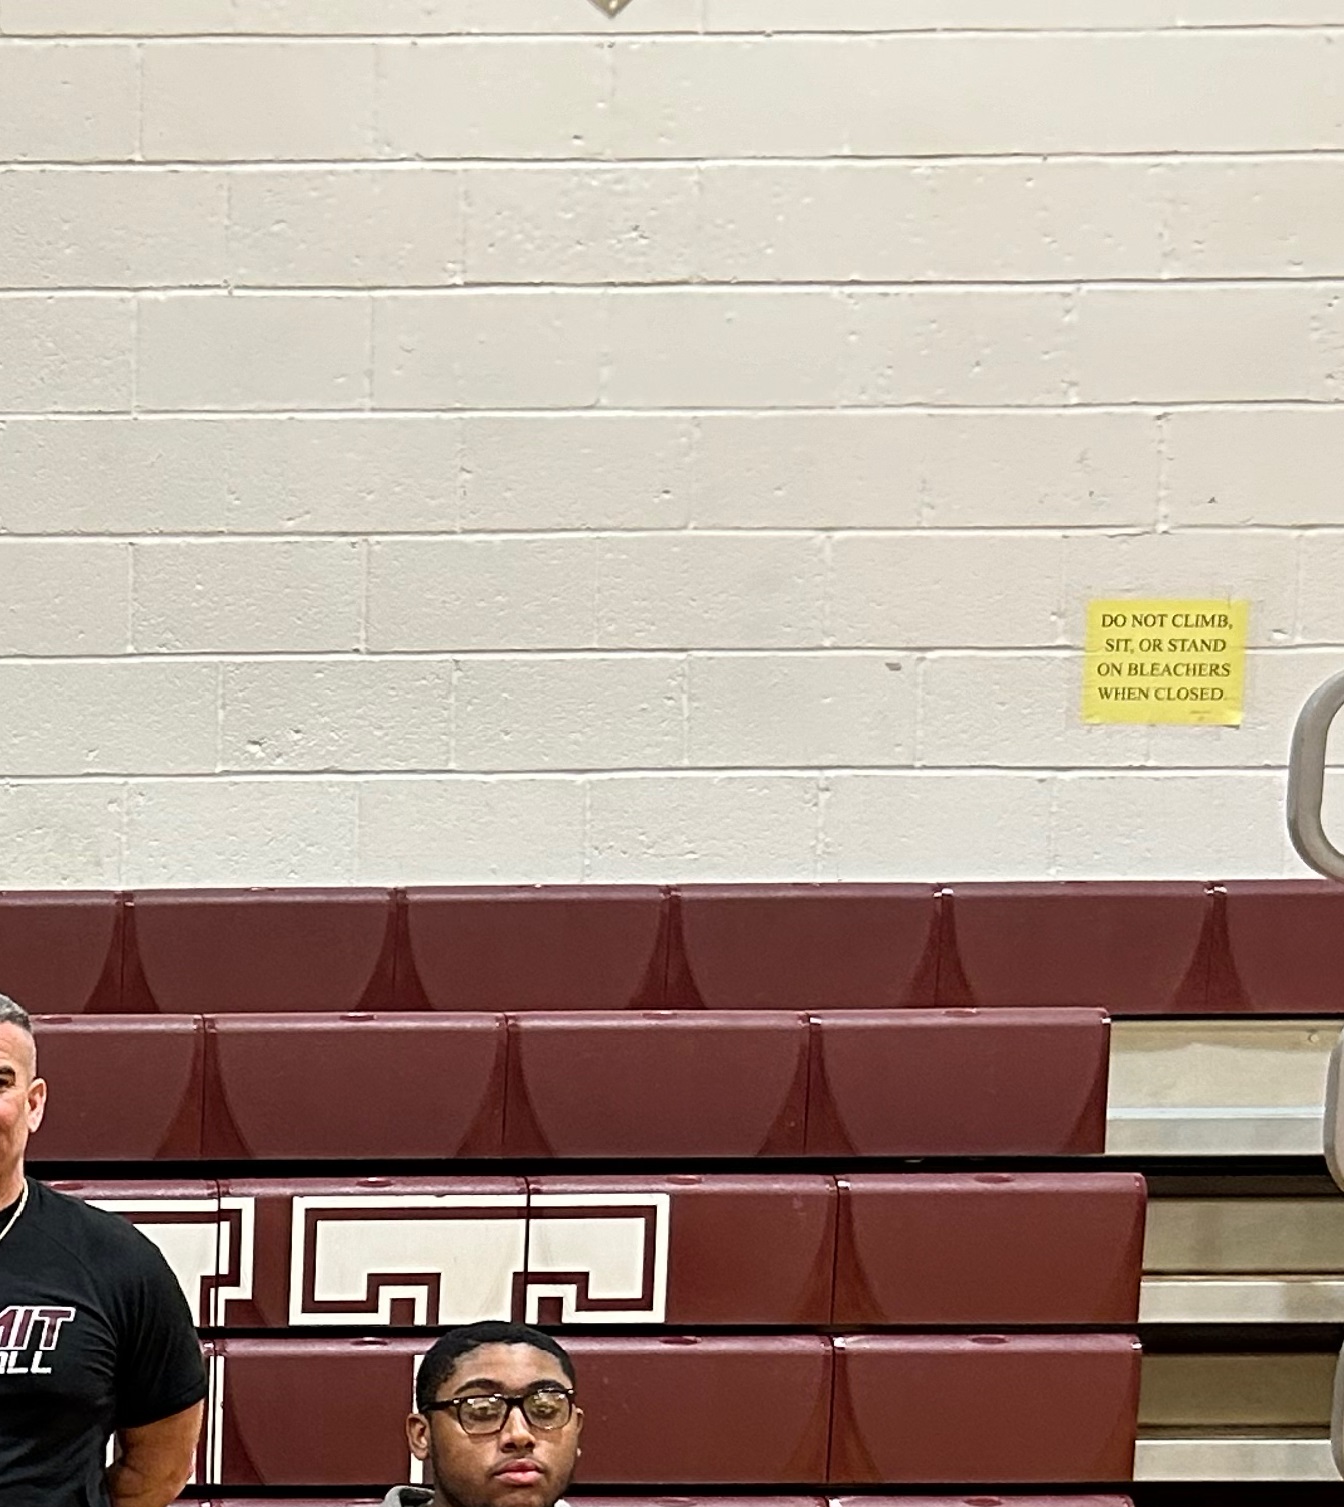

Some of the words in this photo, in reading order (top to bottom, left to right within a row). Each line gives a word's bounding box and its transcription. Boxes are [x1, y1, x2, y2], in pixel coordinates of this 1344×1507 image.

[1101, 613, 1126, 628] DO
[1131, 613, 1168, 628] NOT
[1171, 613, 1233, 630] CLIMB,
[1104, 638, 1135, 654] SIT,
[1139, 638, 1162, 652] OR
[1167, 638, 1227, 652] STAND
[1097, 662, 1122, 677] ON
[1127, 662, 1231, 677] BLEACHERS
[1098, 686, 1150, 701] WHEN
